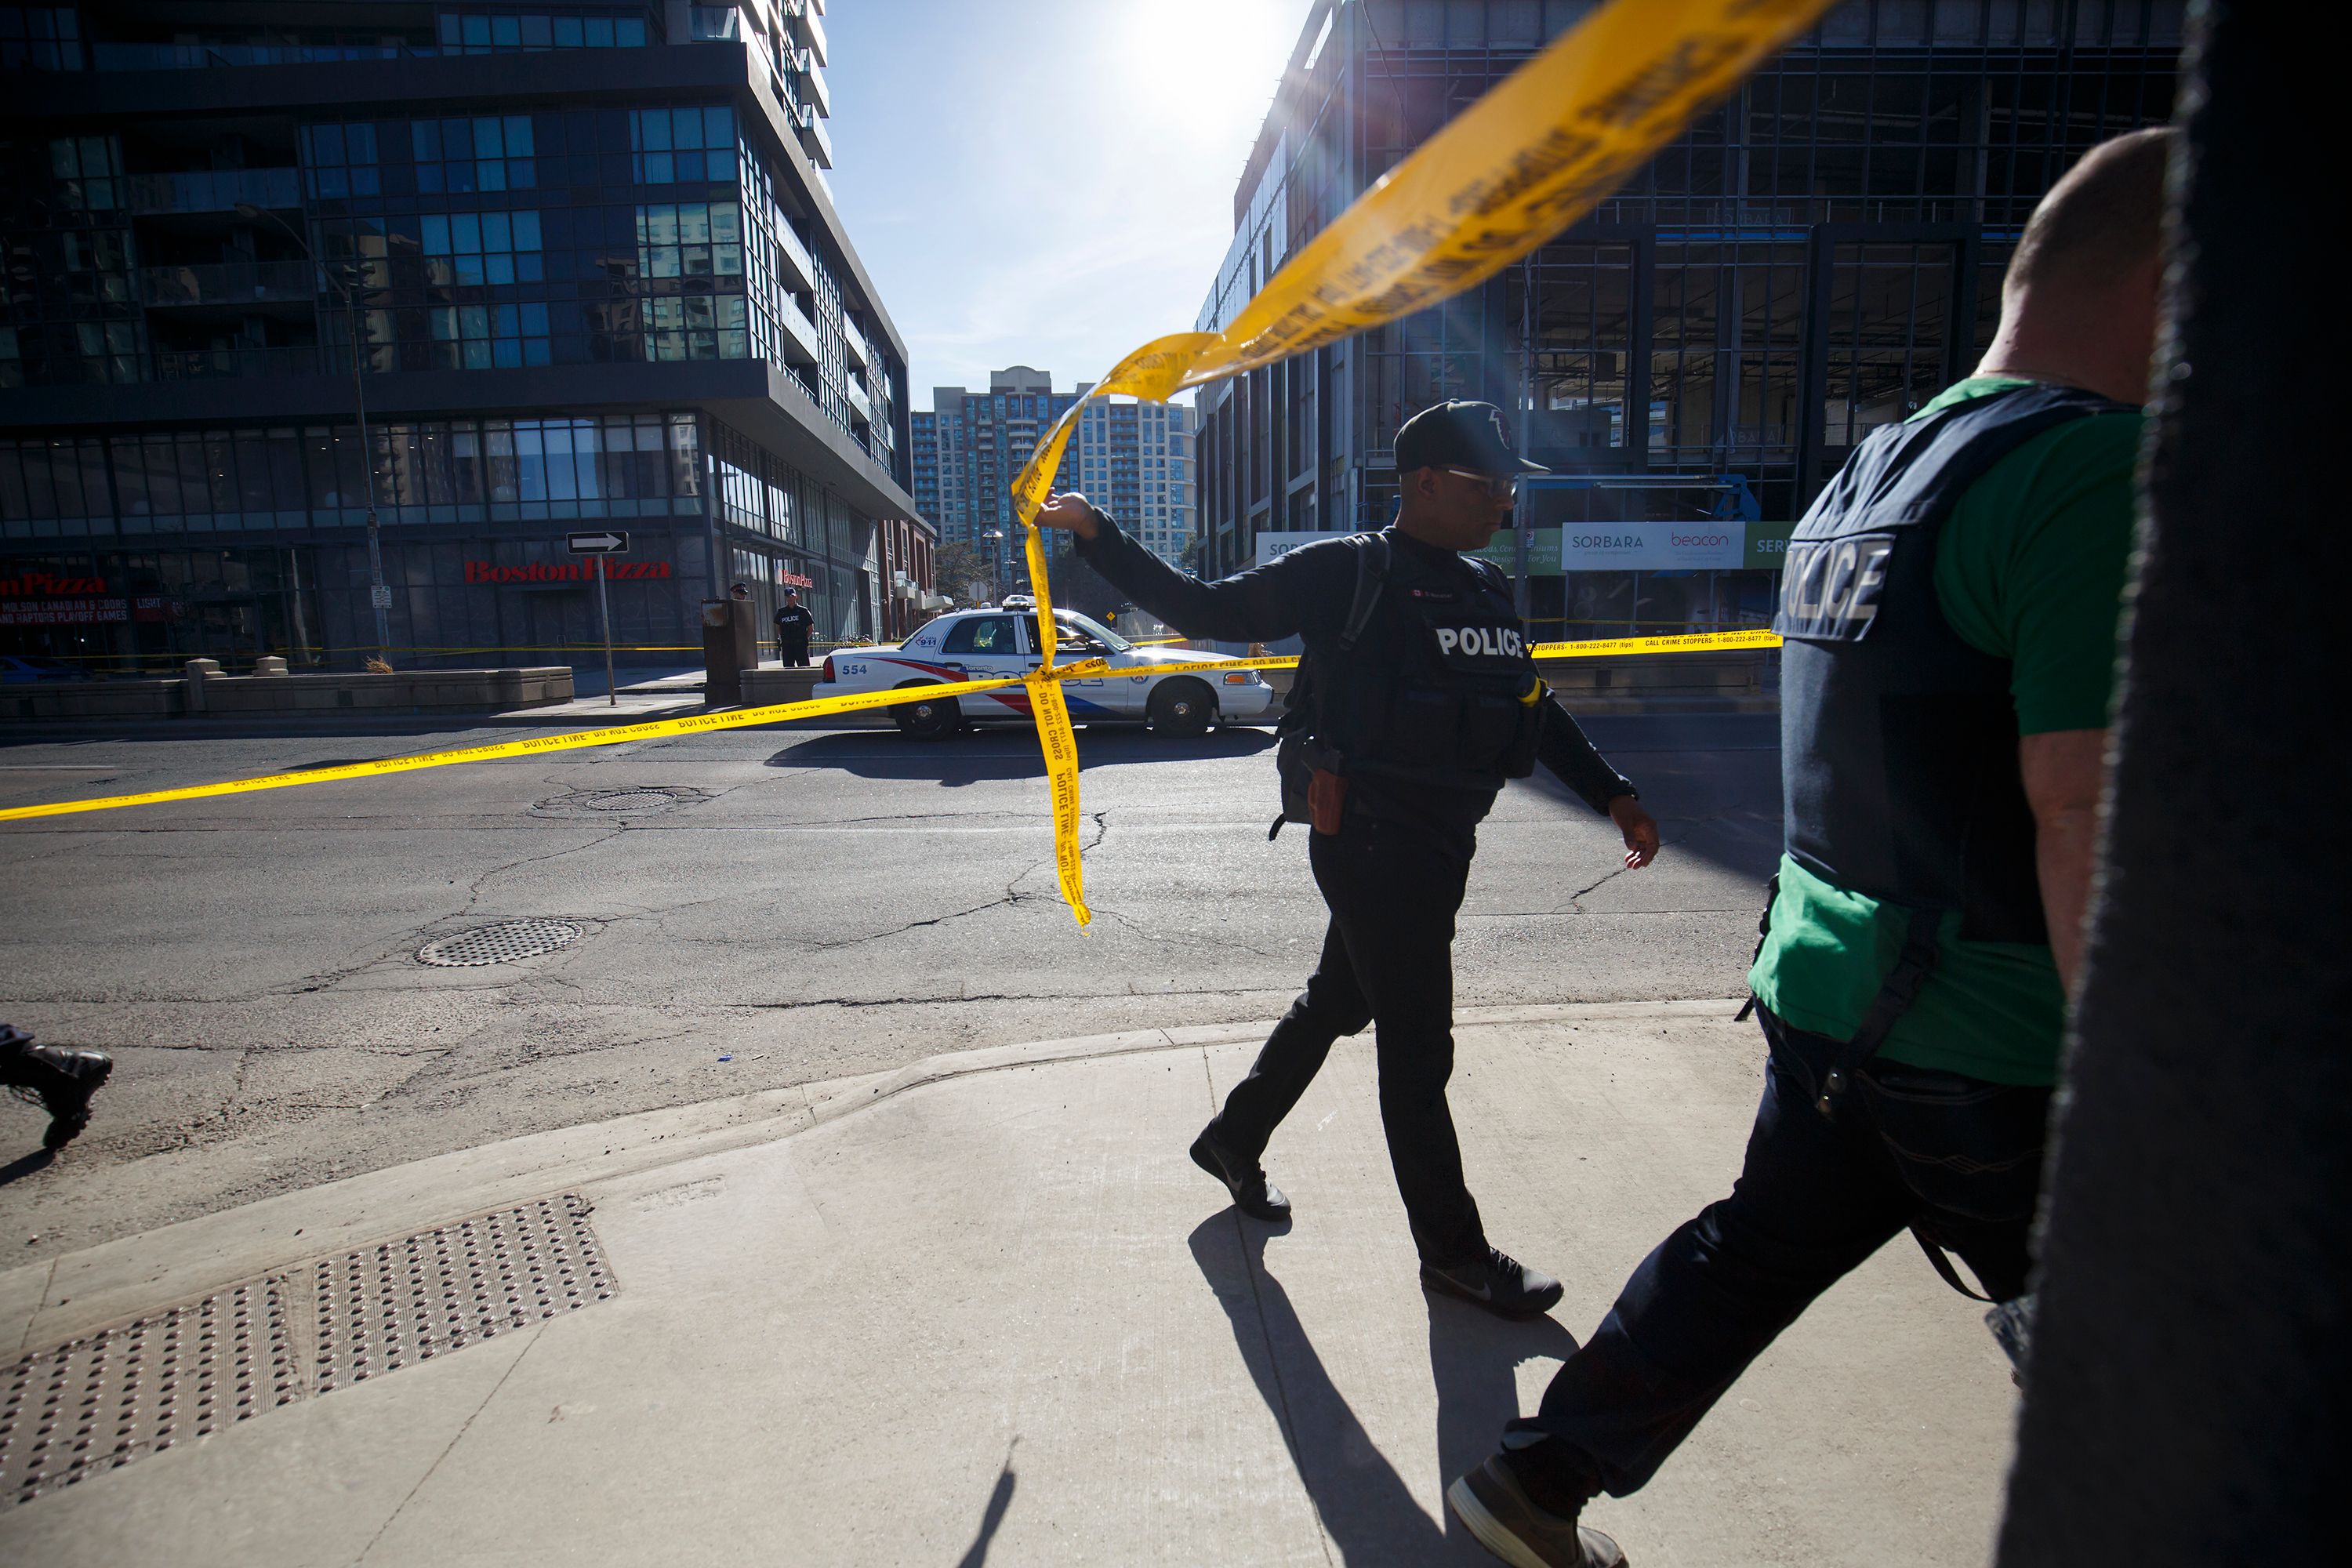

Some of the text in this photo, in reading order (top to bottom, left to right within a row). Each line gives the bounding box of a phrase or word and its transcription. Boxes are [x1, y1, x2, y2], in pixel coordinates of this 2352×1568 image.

[1573, 535, 1644, 548] SORBARA
[1671, 532, 1729, 546] beacon
[1541, 554, 1557, 564] You
[136, 597, 162, 609] LIGHT
[1436, 627, 1524, 659] POLICE
[843, 665, 867, 675] 554
